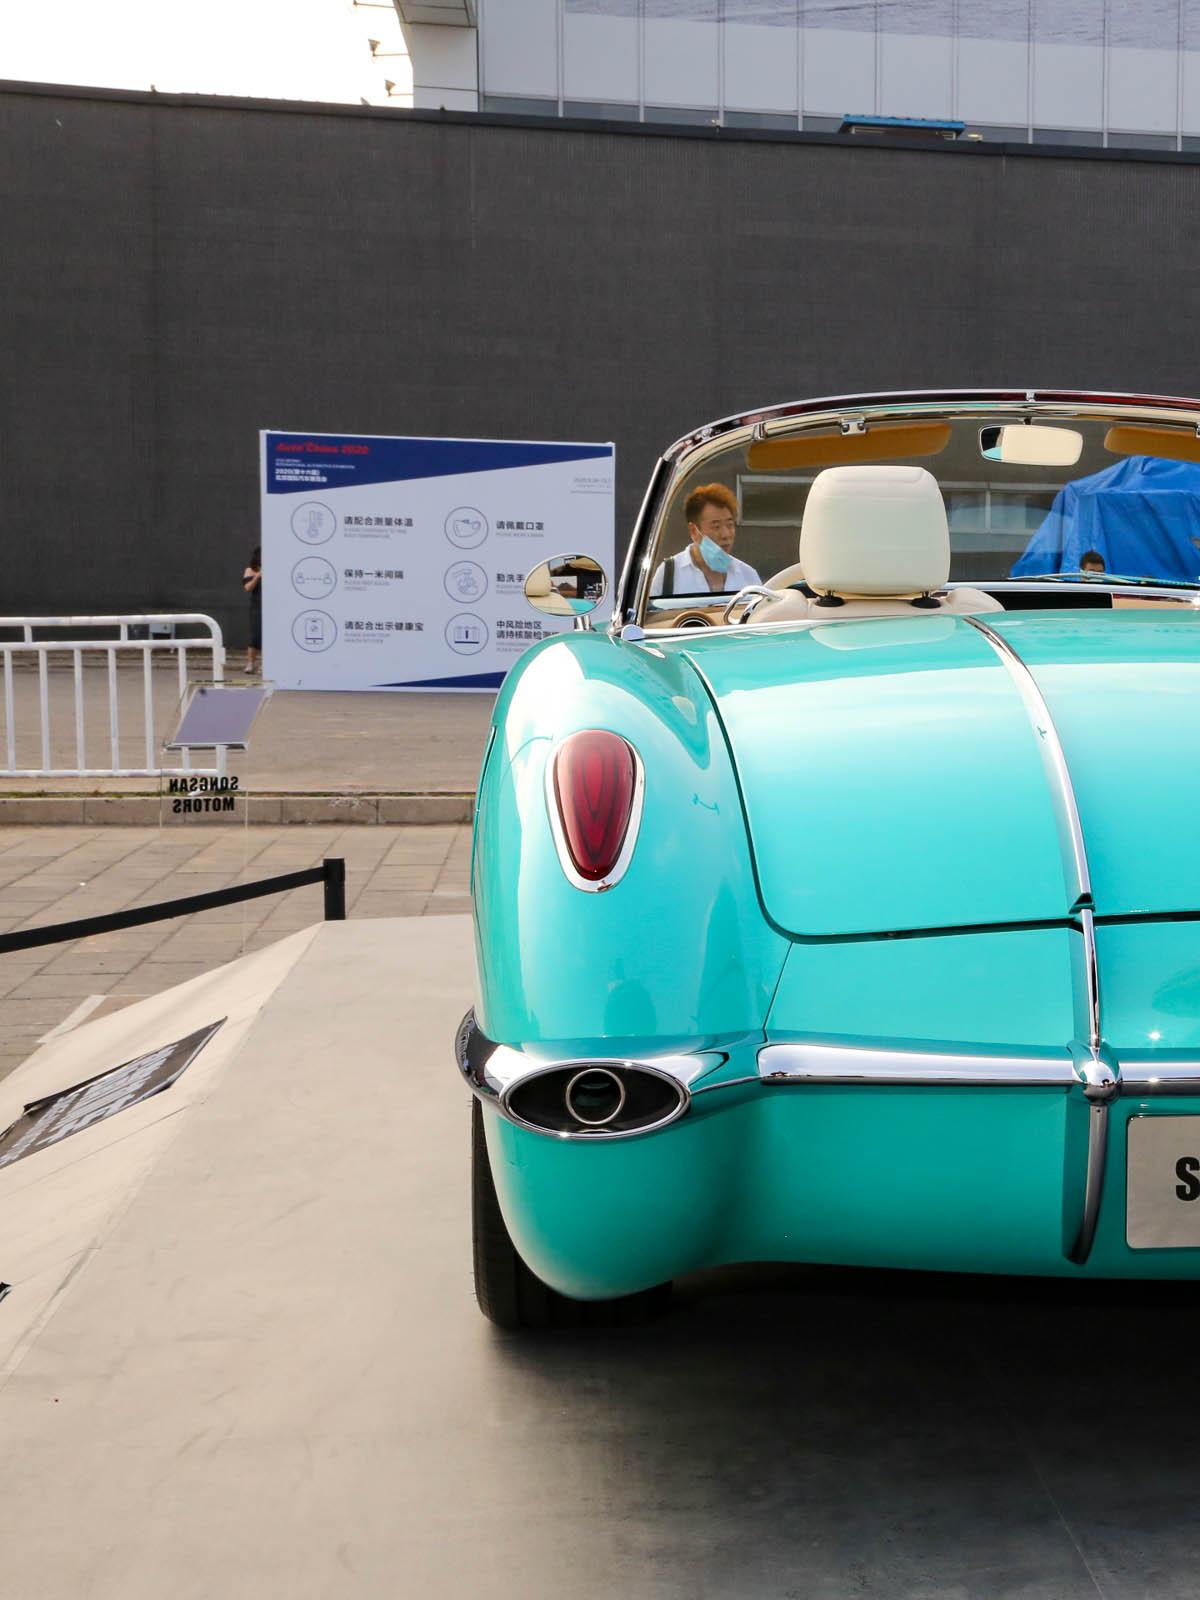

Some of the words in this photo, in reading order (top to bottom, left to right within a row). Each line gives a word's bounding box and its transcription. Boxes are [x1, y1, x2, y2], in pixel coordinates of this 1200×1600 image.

[344, 516, 414, 528] 请配合测量体温
[496, 520, 545, 531] 请佩戴口罩
